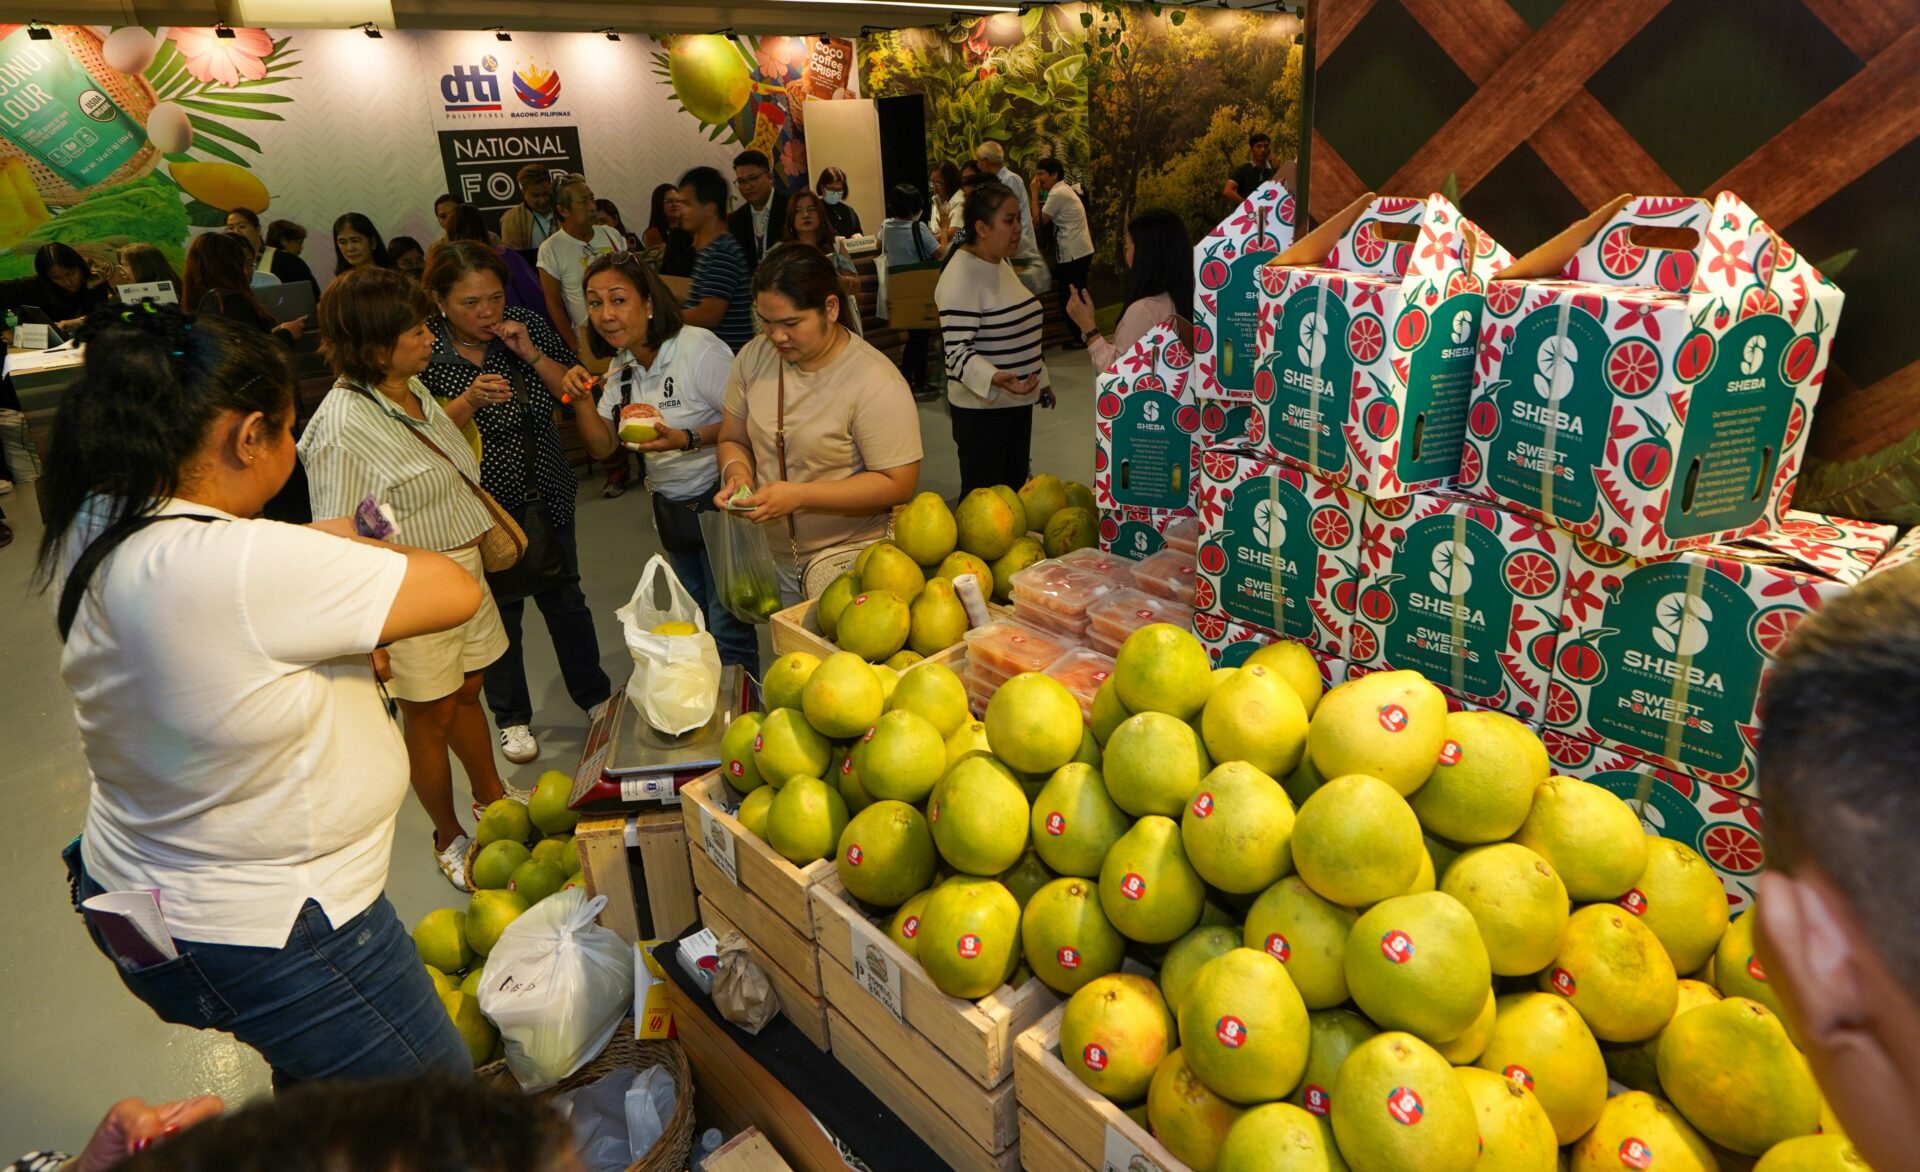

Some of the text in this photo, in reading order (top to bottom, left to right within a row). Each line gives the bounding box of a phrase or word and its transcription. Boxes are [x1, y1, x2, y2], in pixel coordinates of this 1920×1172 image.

[816, 41, 844, 59] COCO
[812, 53, 844, 71] coffee
[441, 54, 501, 103] dti
[85, 95, 103, 110] USDA
[446, 112, 504, 120] PHILIPPINES
[510, 110, 571, 119] BAGONG PILIPINAS
[453, 135, 566, 159] NATIONAL
[1441, 347, 1475, 359] SHEBA
[1283, 368, 1335, 397] SHEBA
[1726, 378, 1767, 392] SHEBA
[658, 399, 681, 409] SHEBA
[1287, 404, 1325, 422] SWEET
[1136, 422, 1165, 431] SHEBA
[1510, 417, 1546, 433] HARVESTING
[1512, 400, 1584, 436] SHEBA
[1516, 441, 1568, 464] SWEET
[1237, 546, 1298, 576] SHEBA
[1244, 577, 1288, 596] SWEET
[1408, 606, 1447, 622] HARVESTING
[1409, 592, 1486, 626] SHEBA
[1416, 626, 1472, 648] SWEET
[1424, 661, 1449, 673] NORTH
[1621, 665, 1673, 685] HARVESTING
[1623, 649, 1725, 693] SHEBA
[1631, 688, 1704, 716] SWEET
[1617, 696, 1714, 734] POMELOS
[1602, 716, 1638, 733] M'LANG,
[1640, 729, 1671, 743] NORTH
[648, 1007, 670, 1015] Smart
